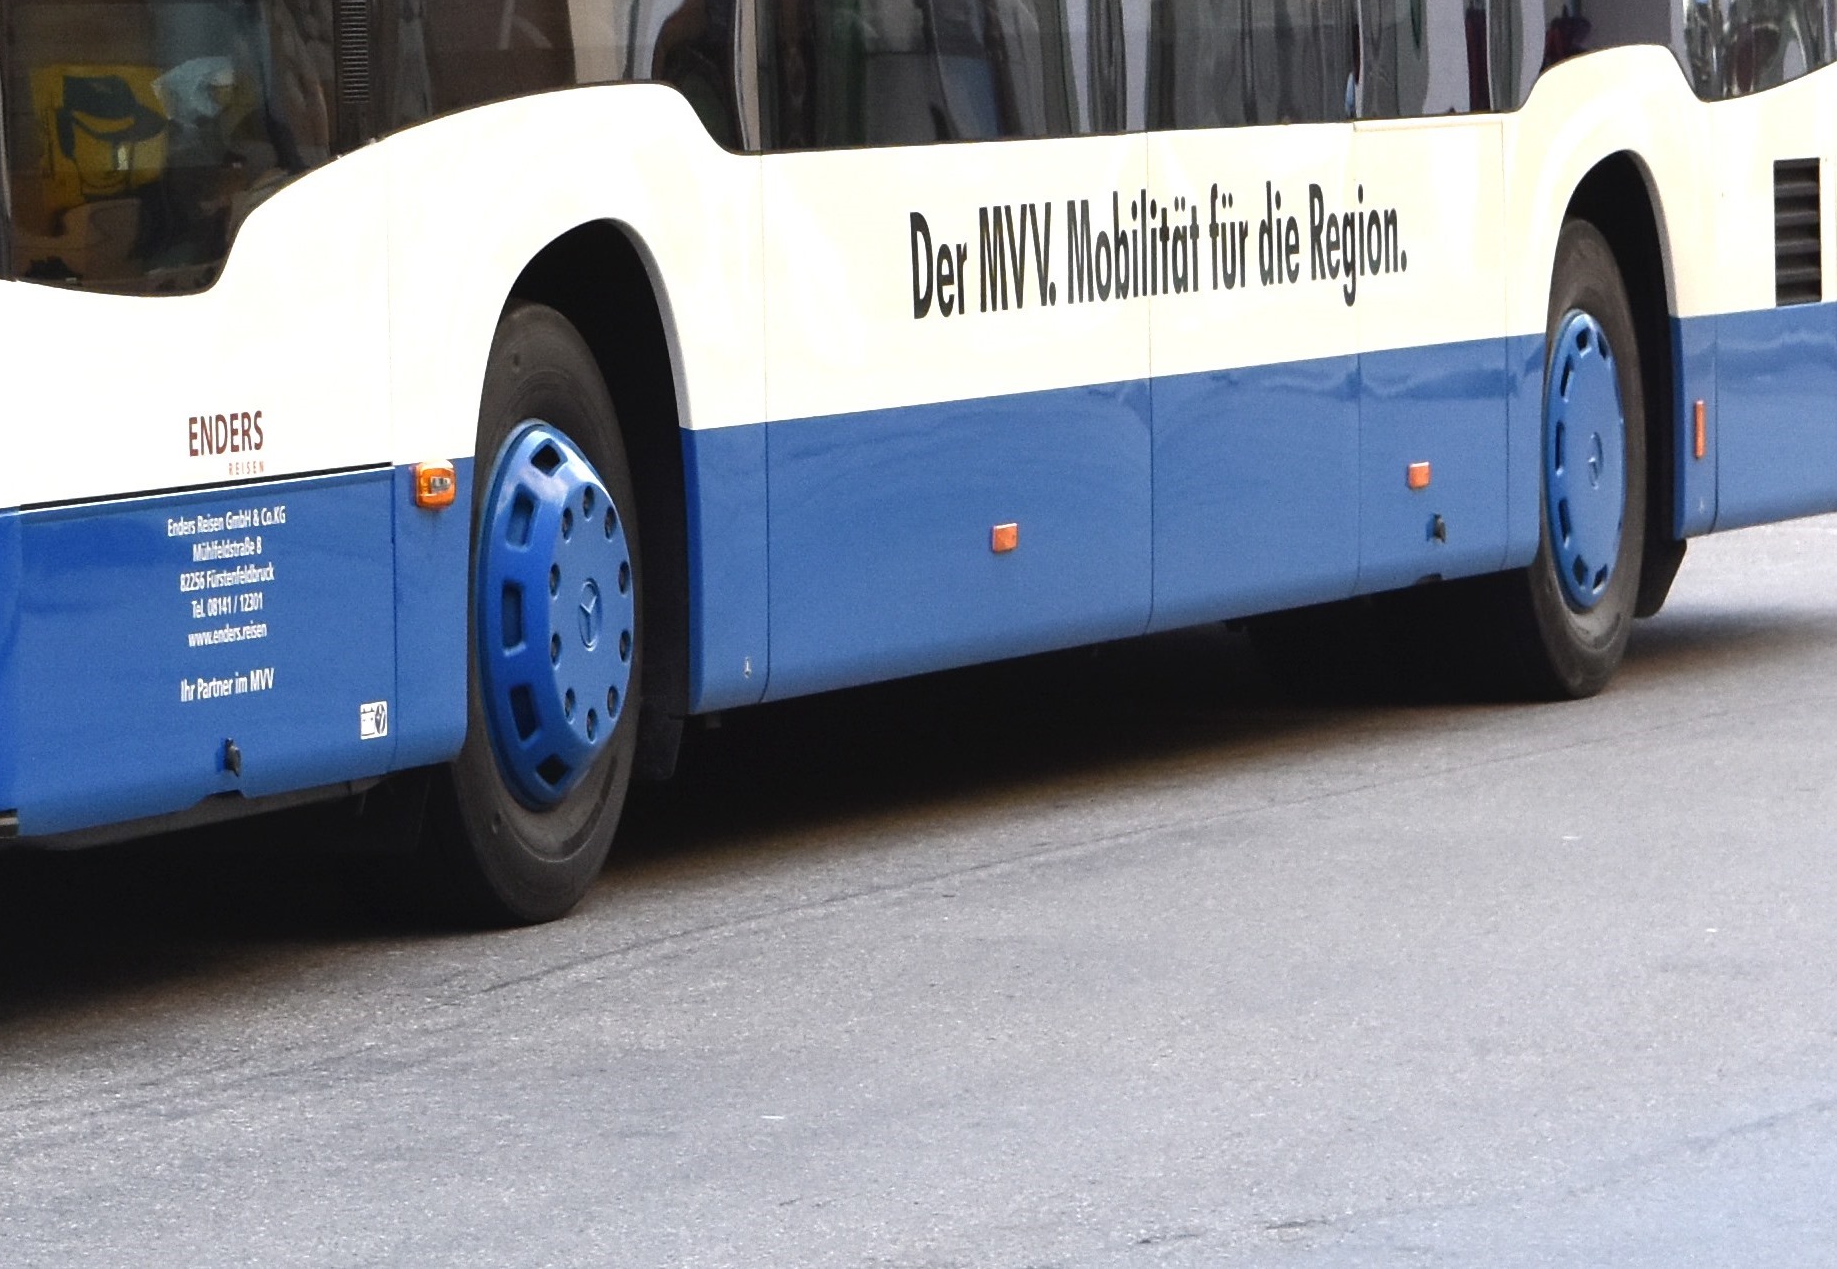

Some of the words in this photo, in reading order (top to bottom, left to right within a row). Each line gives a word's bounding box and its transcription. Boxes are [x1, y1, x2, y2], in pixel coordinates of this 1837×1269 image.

[909, 211, 967, 319] Der
[978, 202, 1057, 313] MVV.
[1066, 188, 1200, 304] Mobilität
[1208, 183, 1249, 291] für
[1258, 180, 1300, 287] die
[1308, 183, 1407, 307] Region.
[188, 410, 264, 457] ENDERS
[228, 460, 264, 476] REISEN
[167, 516, 196, 537] Enders
[197, 513, 225, 533] Reisen
[225, 509, 252, 530] GmbH
[252, 508, 259, 527] &
[192, 536, 255, 562] Mühlfeldstraße
[256, 536, 262, 555] 8
[180, 570, 206, 593] 82256
[206, 561, 275, 589] Fürstenfeldbruck
[191, 598, 206, 619] Tel.
[207, 596, 232, 617] 08141
[239, 591, 263, 612] 12301
[188, 619, 268, 648] www.enders.reisen
[180, 678, 196, 703] Ihr
[196, 677, 234, 701] Partner
[234, 671, 248, 695] im
[250, 667, 275, 693] MVV
